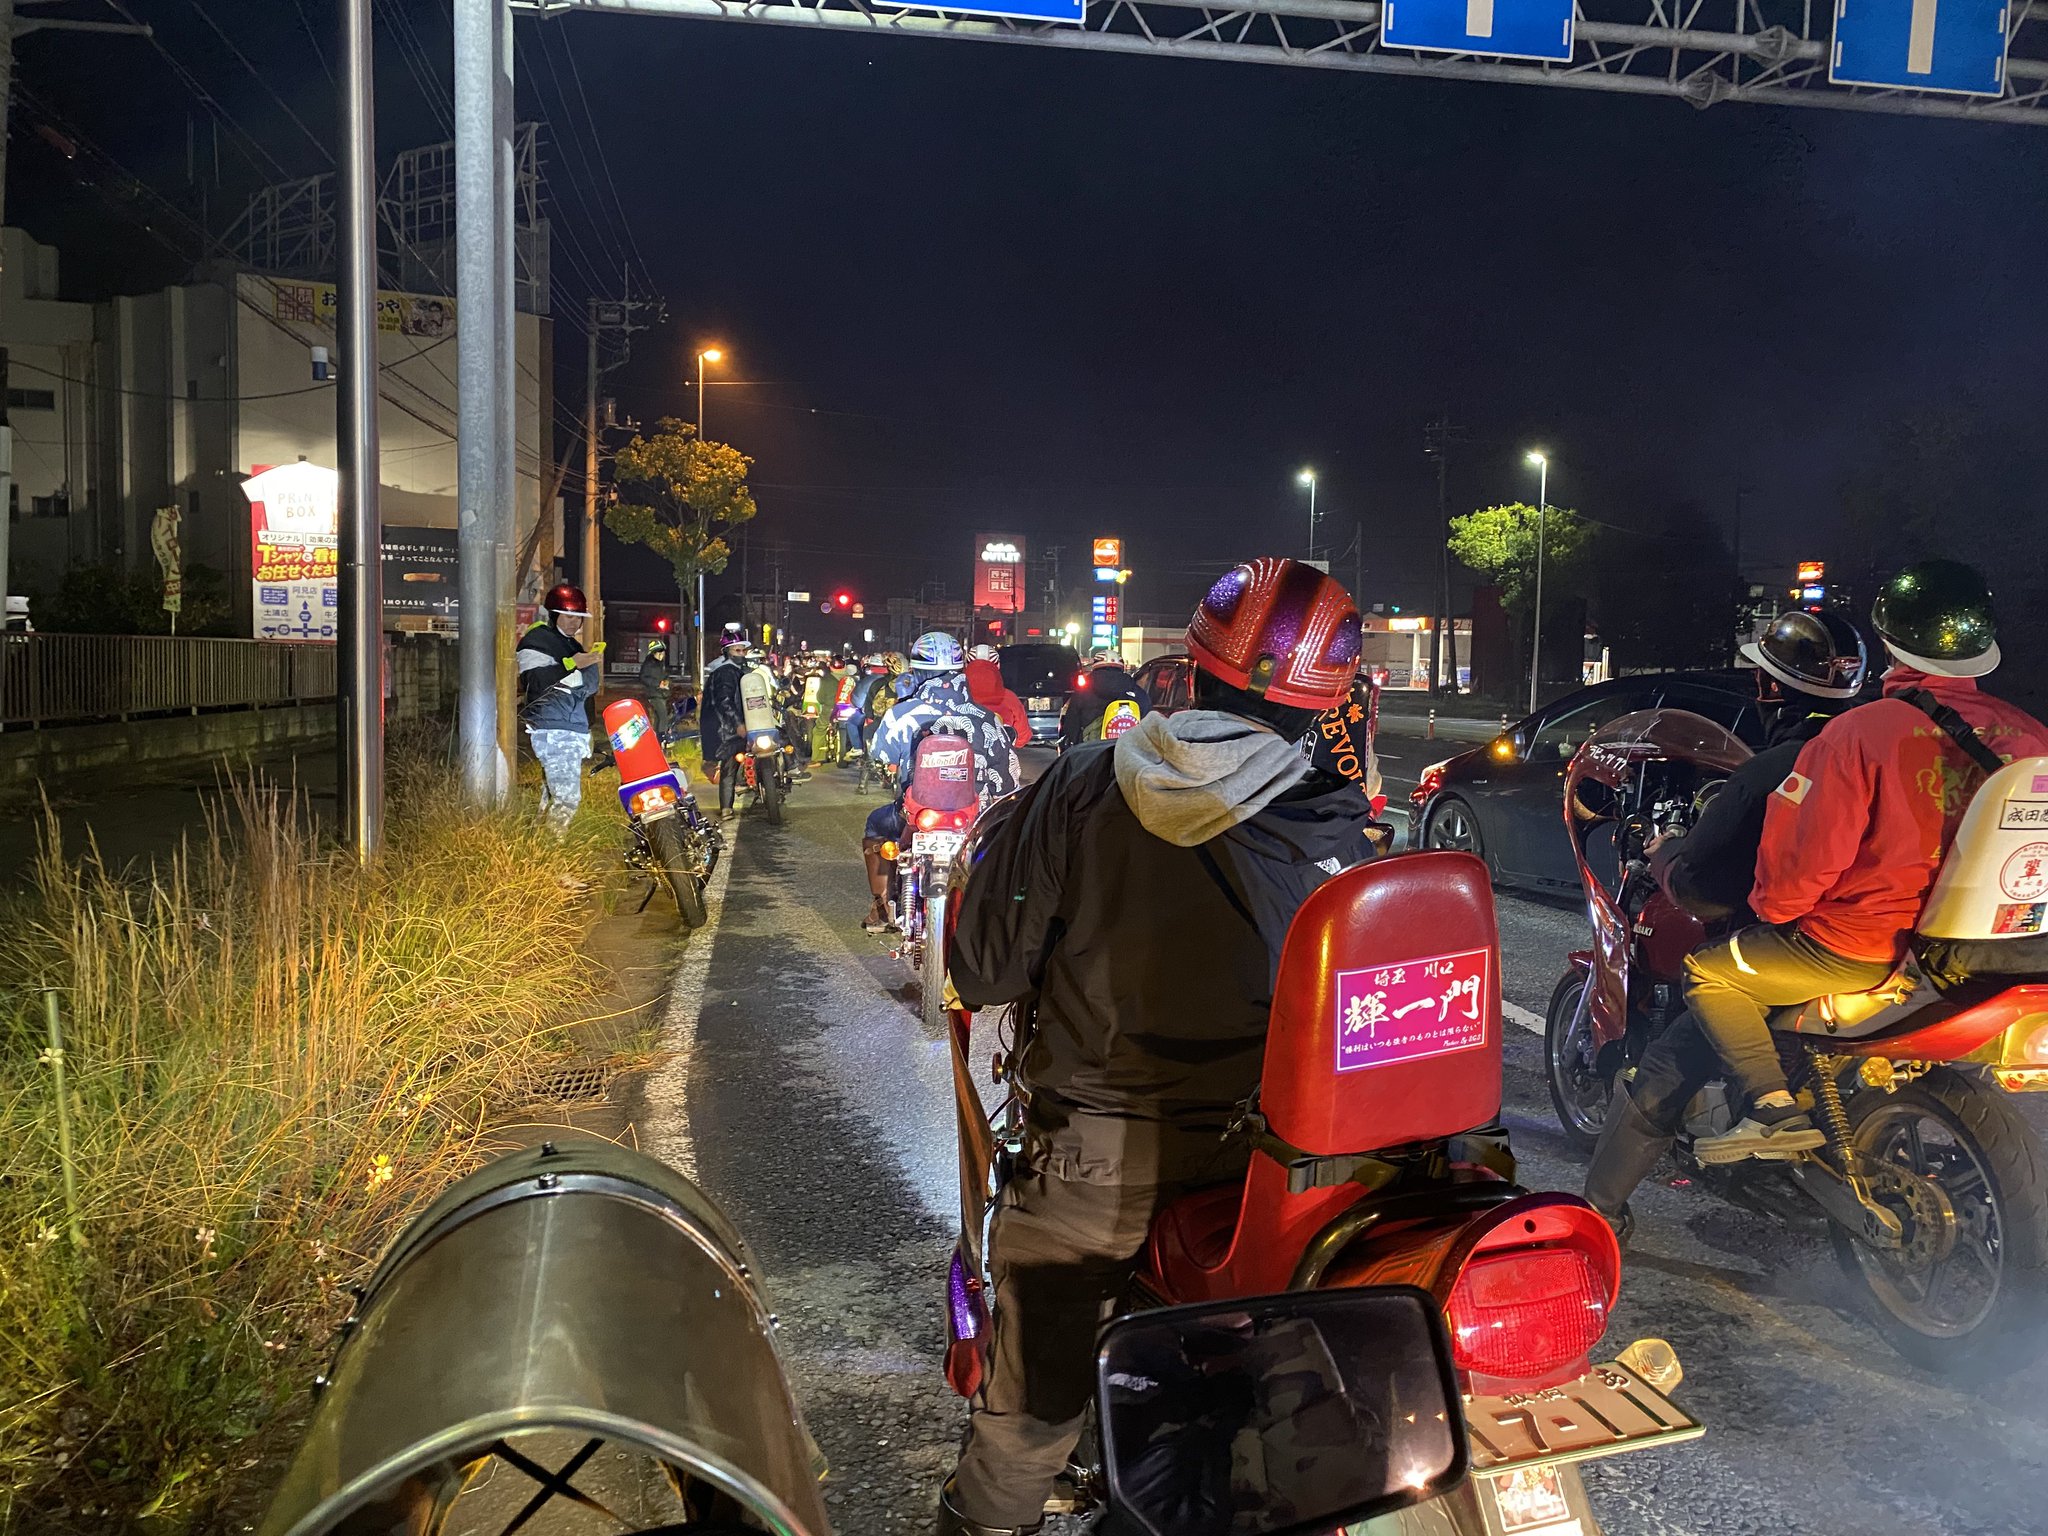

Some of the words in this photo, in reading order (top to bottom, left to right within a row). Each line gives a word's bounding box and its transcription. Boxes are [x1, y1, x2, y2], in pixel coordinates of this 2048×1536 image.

[286, 505, 316, 518] BOX
[262, 534, 301, 543] オリジナル
[1913, 726, 2023, 738] KASAKI
[917, 841, 957, 852] 56-7
[1424, 961, 1455, 979] 川口
[1344, 974, 1481, 1039] 輝一門
